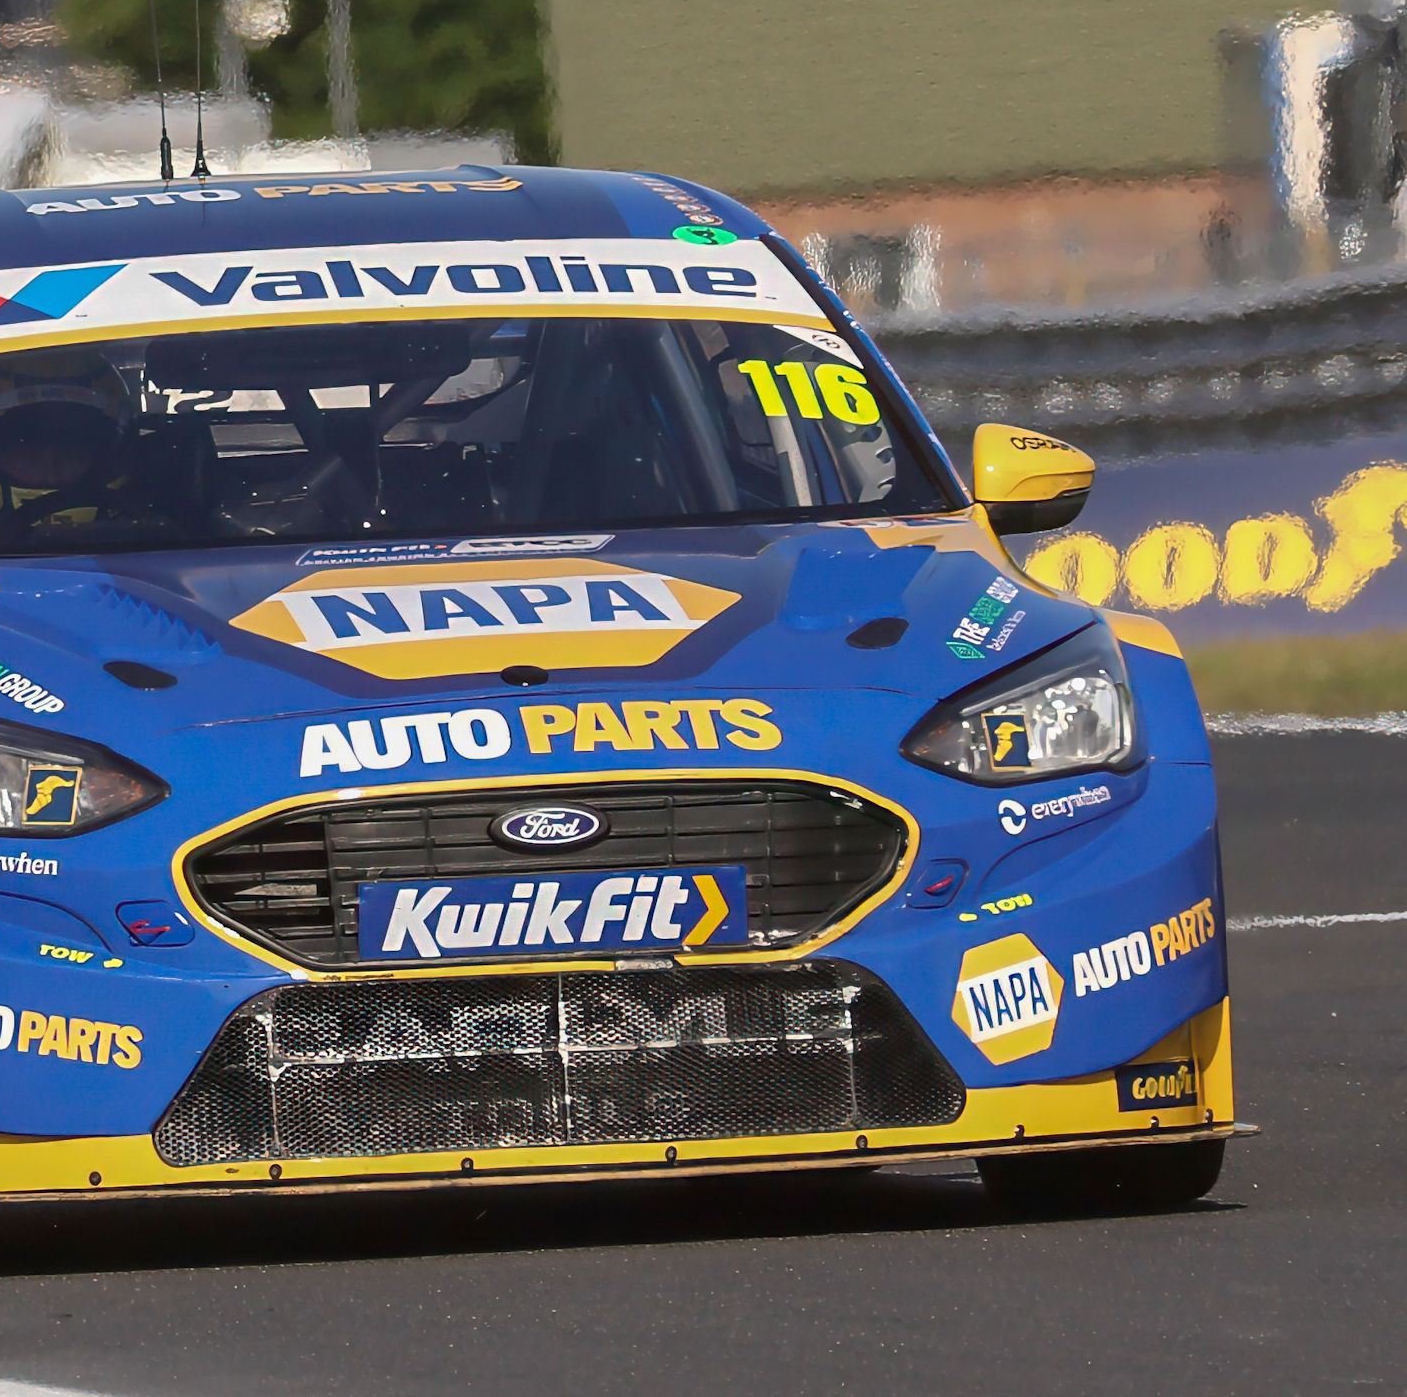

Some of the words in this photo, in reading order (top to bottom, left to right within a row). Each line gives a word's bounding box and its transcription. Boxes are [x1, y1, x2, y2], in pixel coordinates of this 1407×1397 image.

[26, 189, 242, 215] AUTO
[253, 176, 524, 199] PARTS
[149, 256, 759, 308] Valvoline
[737, 359, 882, 426] 116
[311, 580, 671, 639] NAPA
[298, 708, 513, 778] AUTO
[518, 698, 783, 755] PARTS
[520, 812, 581, 839] Ford
[39, 944, 95, 964] TOW
[1072, 930, 1152, 998] AUTO
[1150, 897, 1216, 967] PARTS
[968, 947, 1050, 1032] NAPA
[16, 1010, 144, 1070] PARTS
